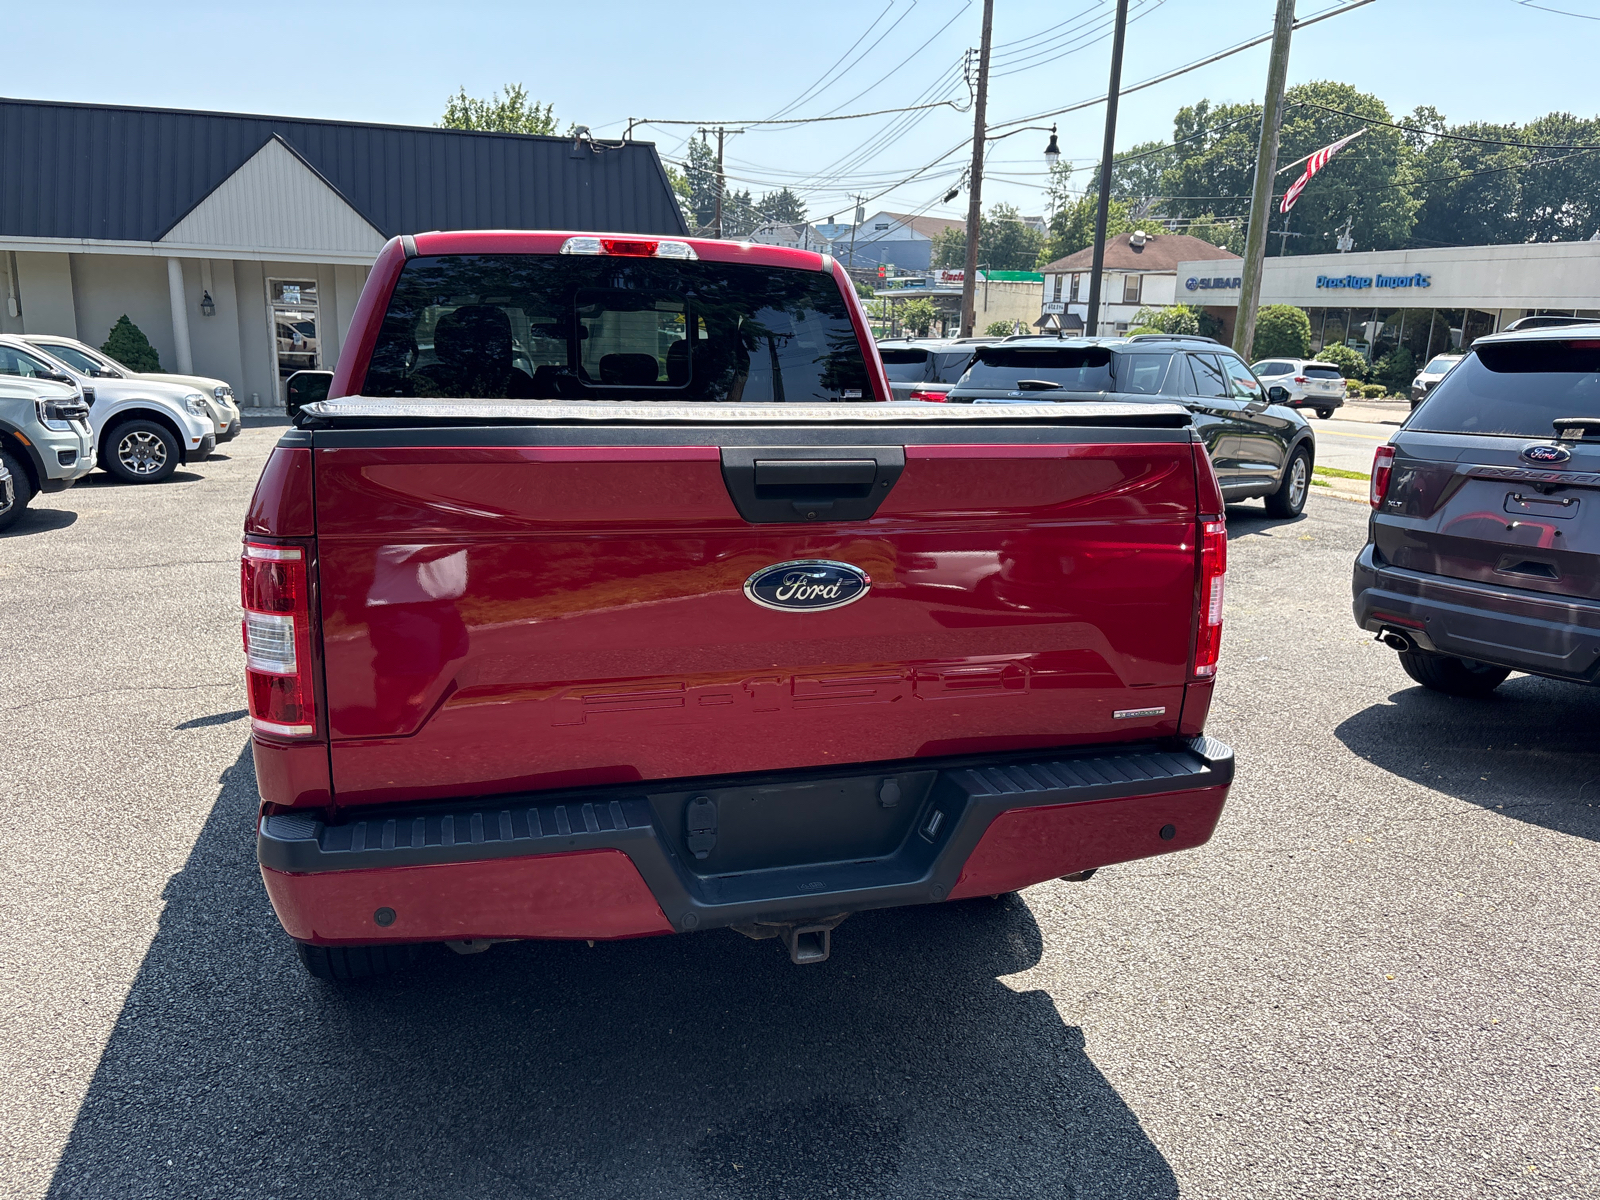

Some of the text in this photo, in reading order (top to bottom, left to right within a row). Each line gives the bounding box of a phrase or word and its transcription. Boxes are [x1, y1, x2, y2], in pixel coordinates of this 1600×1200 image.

[941, 270, 964, 282] Sincla
[1316, 273, 1431, 289] Prestige Imports
[1199, 278, 1241, 289] SUBAR
[1531, 447, 1559, 460] Ford
[1387, 500, 1403, 508] XLT
[775, 571, 843, 601] Ford
[551, 658, 1030, 727] F-150
